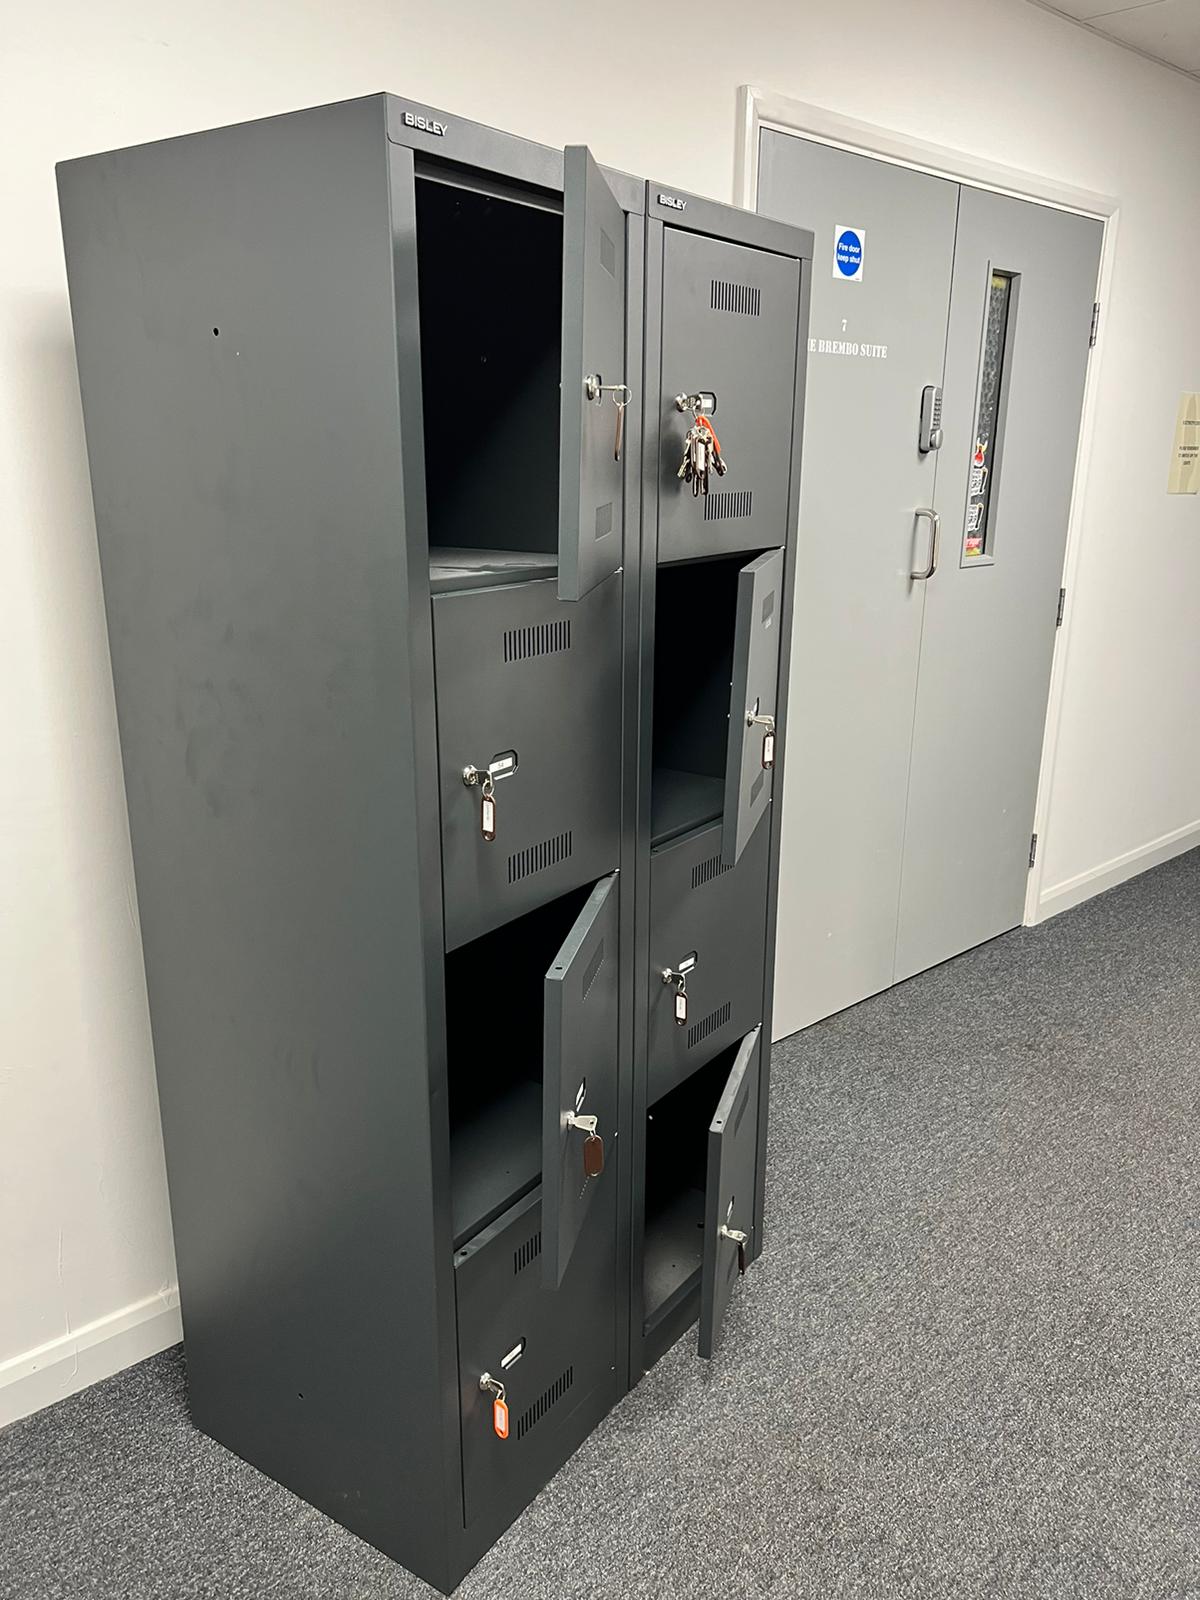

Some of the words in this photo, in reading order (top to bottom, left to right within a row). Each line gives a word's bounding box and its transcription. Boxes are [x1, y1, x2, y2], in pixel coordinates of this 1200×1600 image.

[404, 111, 448, 137] BISLEY
[659, 194, 687, 210] BISLEY
[838, 242, 849, 251] Fire
[849, 245, 861, 253] door
[837, 253, 849, 263] keep
[849, 256, 861, 264] shut
[841, 318, 848, 332] 7
[818, 339, 859, 356] BREMBO
[860, 343, 888, 359] SUITE
